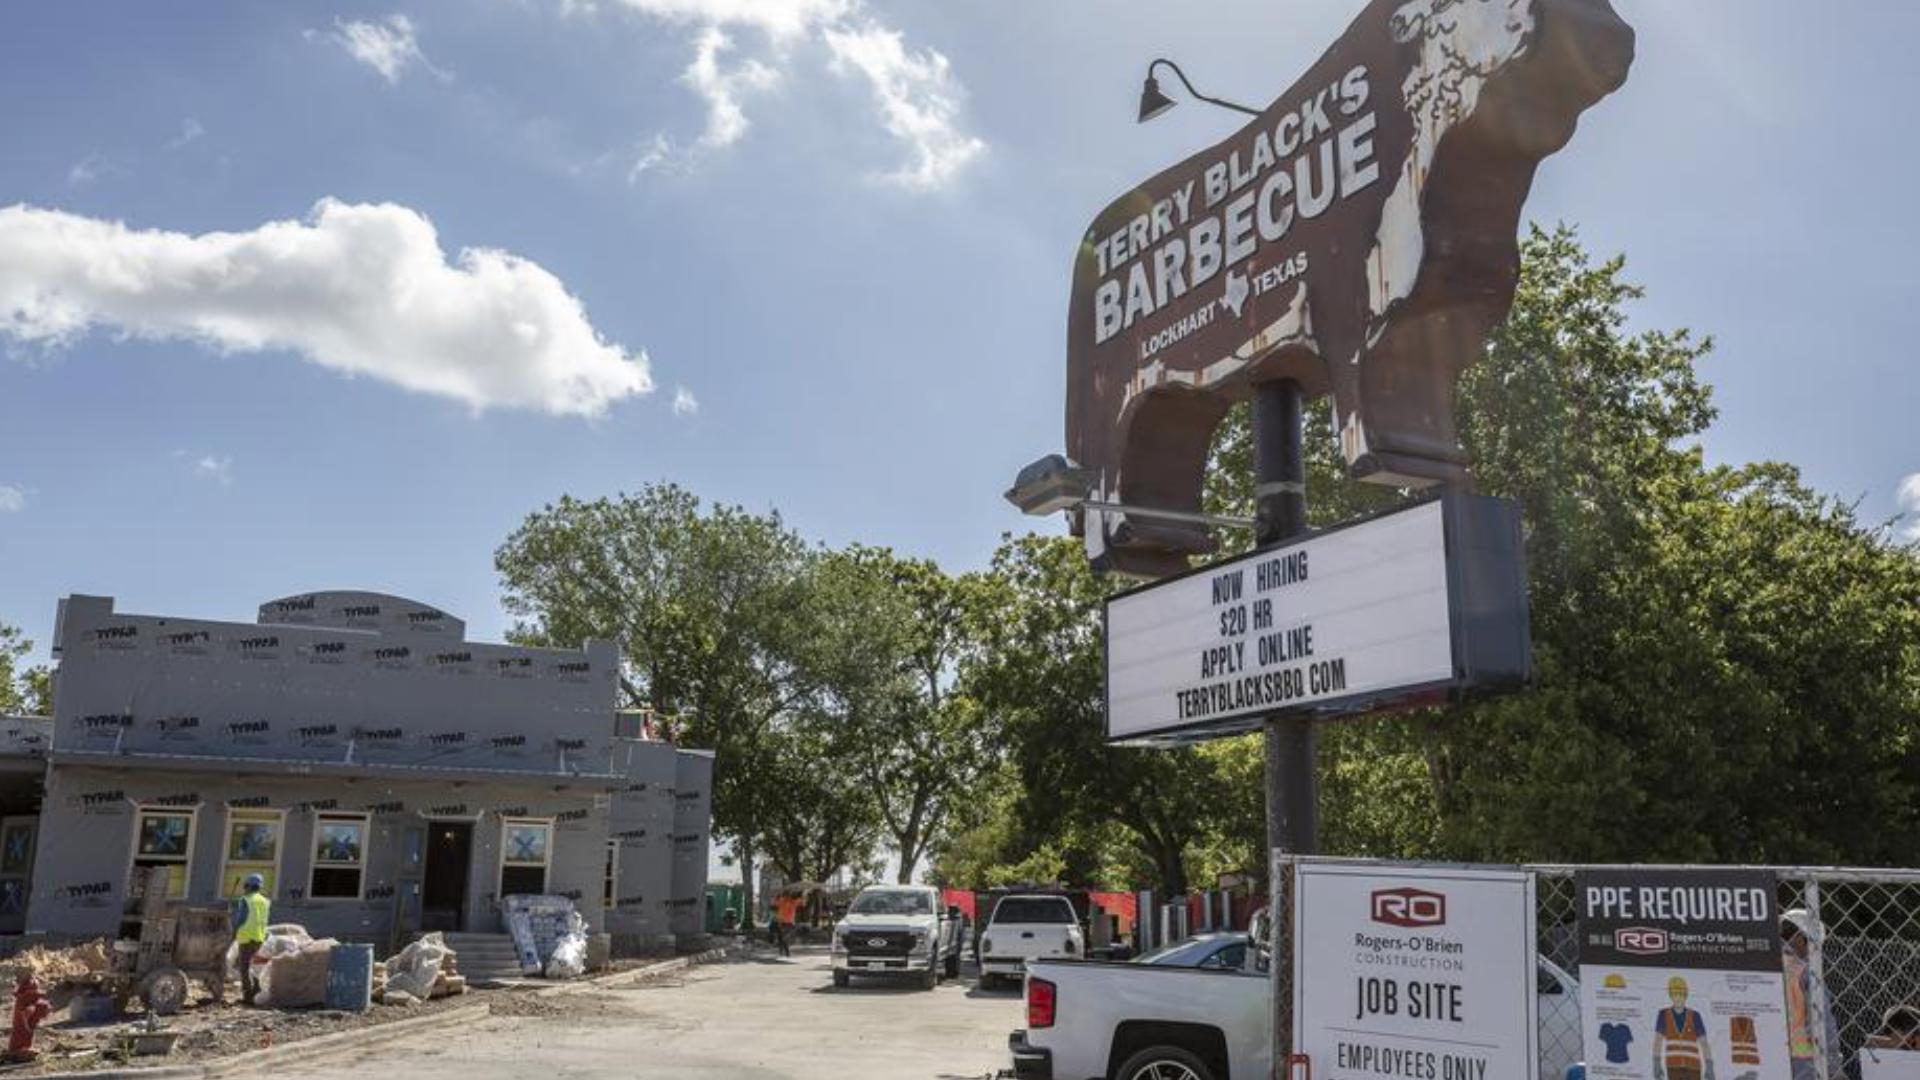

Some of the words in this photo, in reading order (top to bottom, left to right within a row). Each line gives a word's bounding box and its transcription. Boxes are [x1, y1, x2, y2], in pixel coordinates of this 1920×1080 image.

[1094, 181, 1194, 277] TERRY
[1204, 65, 1369, 208] BLACK'S
[1095, 112, 1379, 345] BARBECUE
[1141, 301, 1216, 359] LOCKHART
[1253, 252, 1308, 297] TEXAS
[1212, 570, 1244, 605] NOW
[1256, 551, 1308, 592] HIRING
[1219, 606, 1247, 638] $20
[1253, 599, 1273, 630] HR
[1202, 642, 1244, 679] APPLY
[1258, 625, 1314, 666] ONLINE
[1176, 668, 1304, 720] TERRYBLACKSBBQ
[1309, 659, 1346, 695] COM
[229, 722, 269, 734] TYPAR
[82, 790, 124, 804] TYPAR
[66, 883, 111, 896] TYPAR
[1375, 892, 1442, 923] RO
[1587, 887, 1633, 918] PPE
[1639, 887, 1768, 924] REQUIRED
[1355, 933, 1463, 953] Rogers-O'Brien
[1355, 953, 1463, 971] CONSTRUCTION
[1356, 977, 1398, 1020] JOB
[1407, 981, 1463, 1022] SITE
[1338, 1043, 1436, 1079] EMPLOYEES
[1443, 1055, 1487, 1080] ONLY
